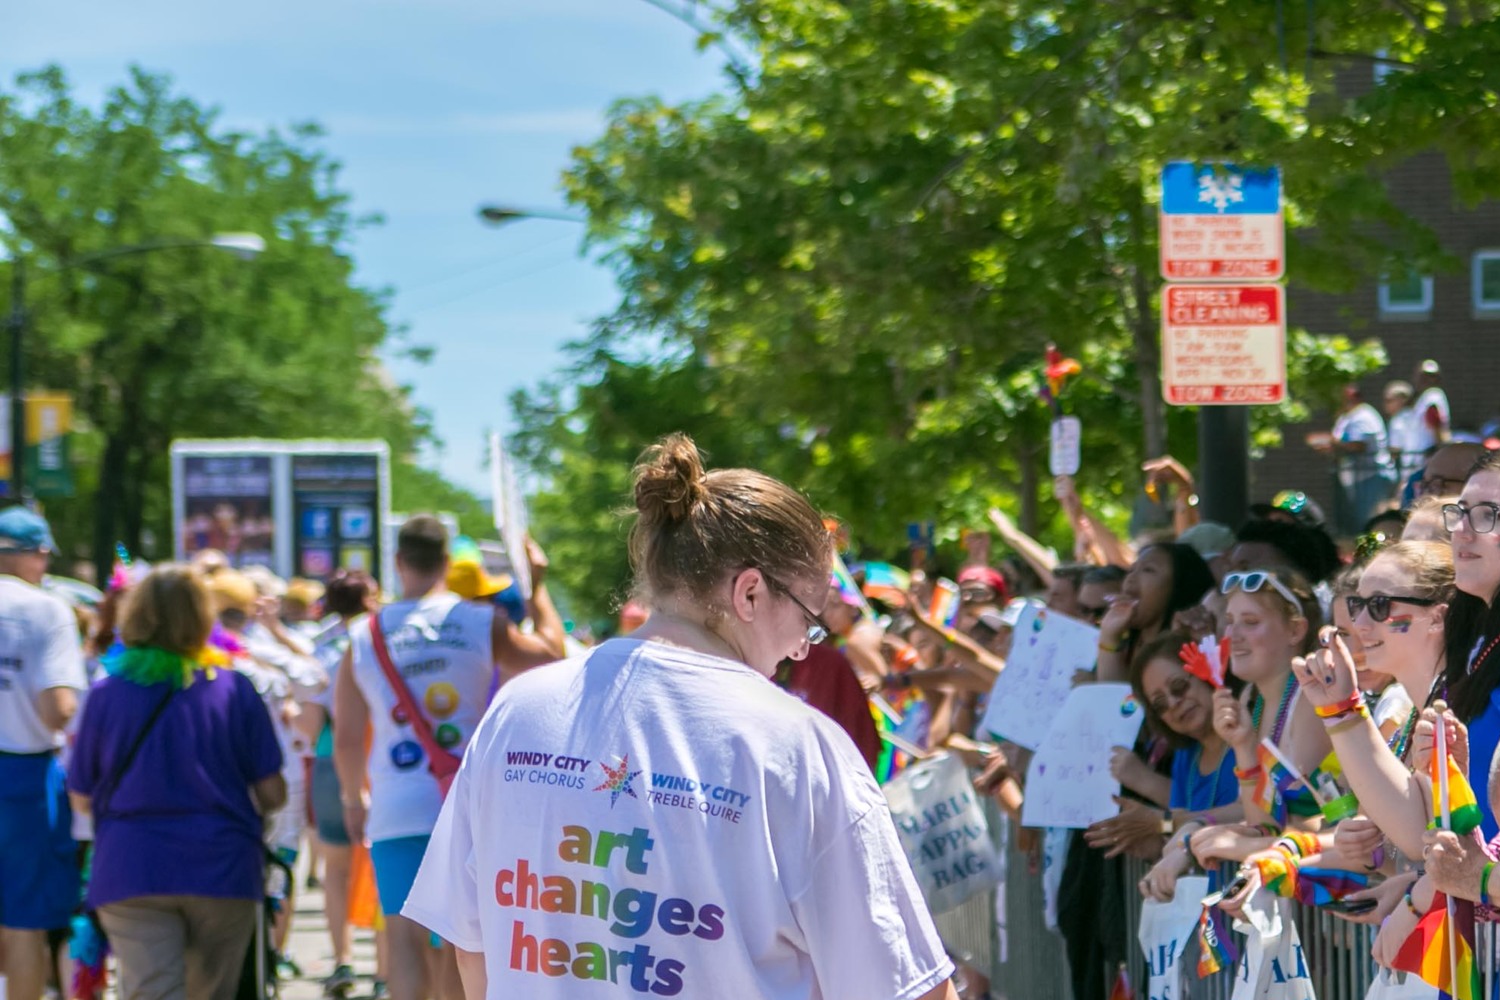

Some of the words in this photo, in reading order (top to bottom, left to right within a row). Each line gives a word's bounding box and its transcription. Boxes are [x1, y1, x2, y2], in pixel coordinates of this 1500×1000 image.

[1171, 261, 1213, 276] TOW
[1220, 261, 1272, 276] ZONE
[1172, 290, 1241, 306] STREET
[1172, 305, 1271, 323] CLEANING
[1173, 386, 1214, 401] TOW
[1222, 386, 1273, 401] ZONE
[506, 751, 552, 767] WINDY
[554, 755, 592, 773] CITY
[504, 769, 526, 783] GAY
[528, 771, 586, 790] CHORUS
[650, 772, 709, 797] WINDY
[712, 785, 752, 808] CITY
[646, 790, 694, 810] TREBLE
[698, 800, 742, 824] QUIRE
[557, 824, 655, 875] art
[931, 851, 986, 890] BAG
[494, 858, 726, 941] changes
[509, 920, 687, 997] hearts
